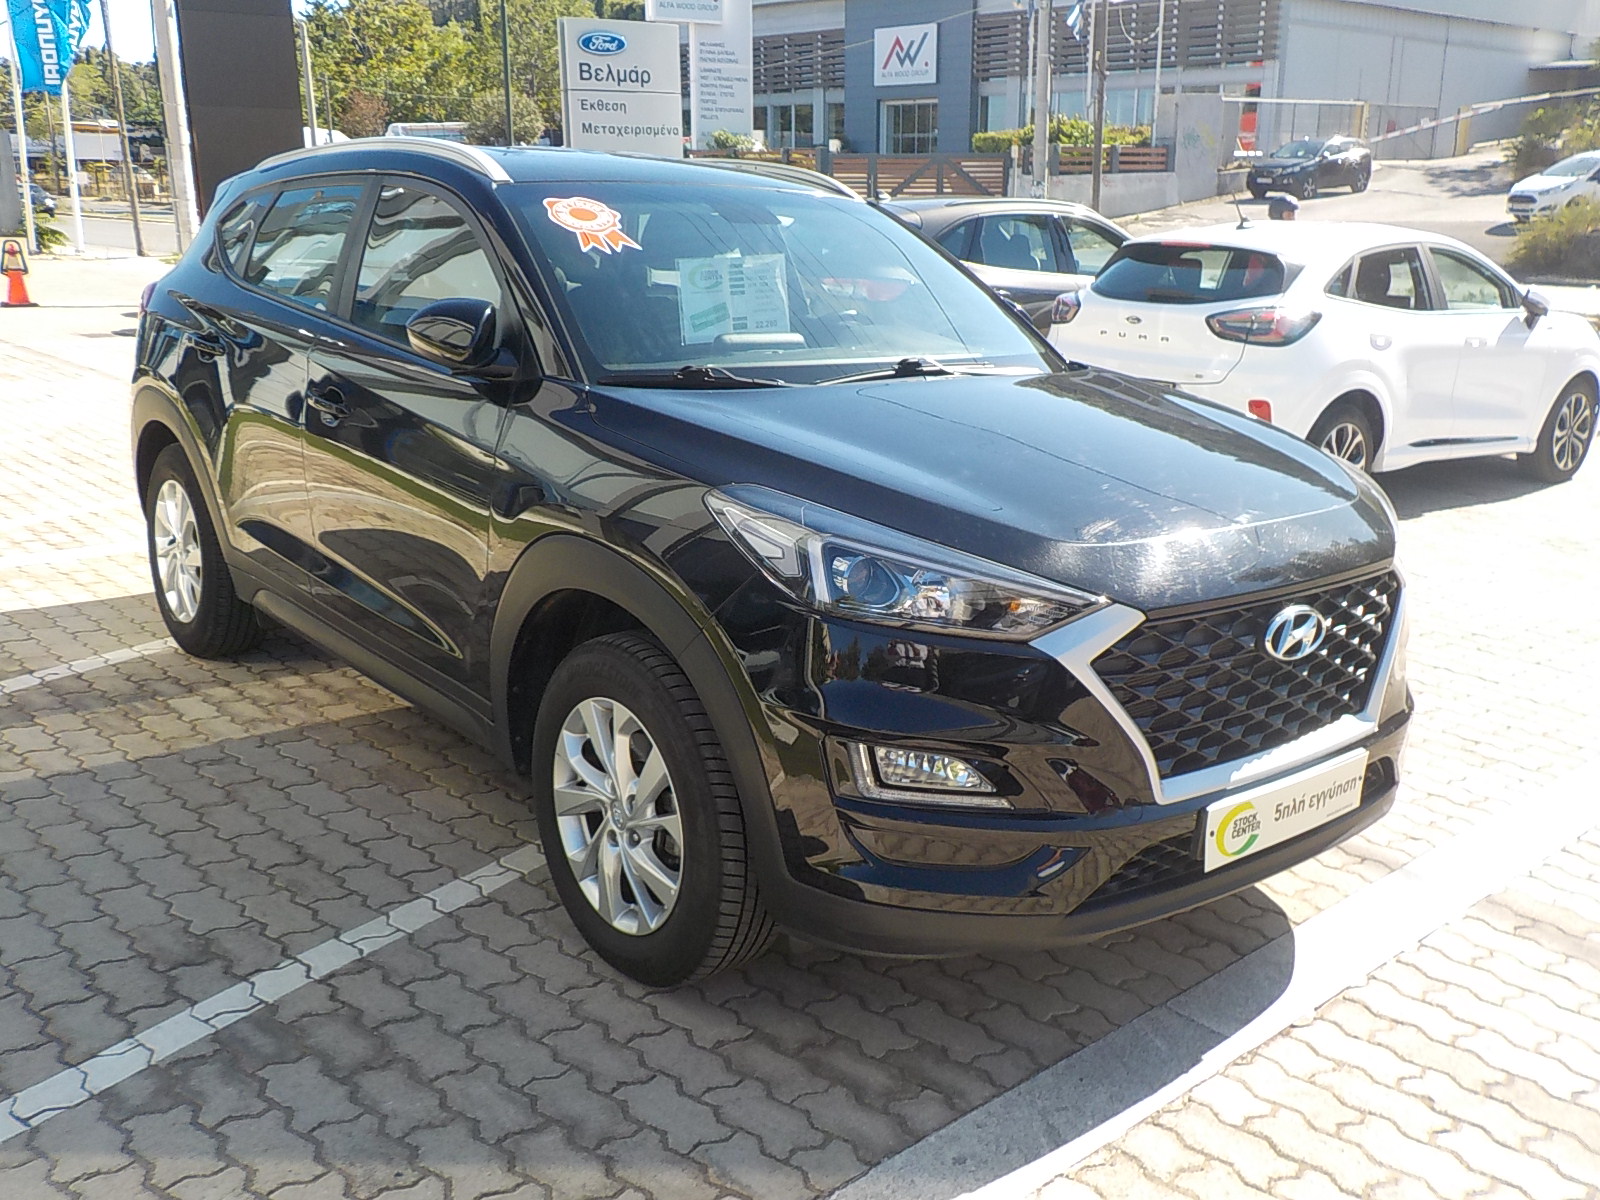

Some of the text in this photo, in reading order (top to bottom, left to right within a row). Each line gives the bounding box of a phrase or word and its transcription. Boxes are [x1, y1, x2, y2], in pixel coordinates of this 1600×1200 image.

[586, 33, 620, 53] Ford
[578, 62, 651, 88] Βελμάρ
[577, 98, 627, 114] Έκθεση
[581, 122, 680, 138] Μεταχειρισμένα
[1100, 329, 1170, 343] PUMA
[1273, 793, 1306, 822] 5πλή
[1308, 776, 1357, 811] εγγύηση
[1231, 820, 1261, 839] CENTER
[1233, 812, 1258, 829] STOCK
